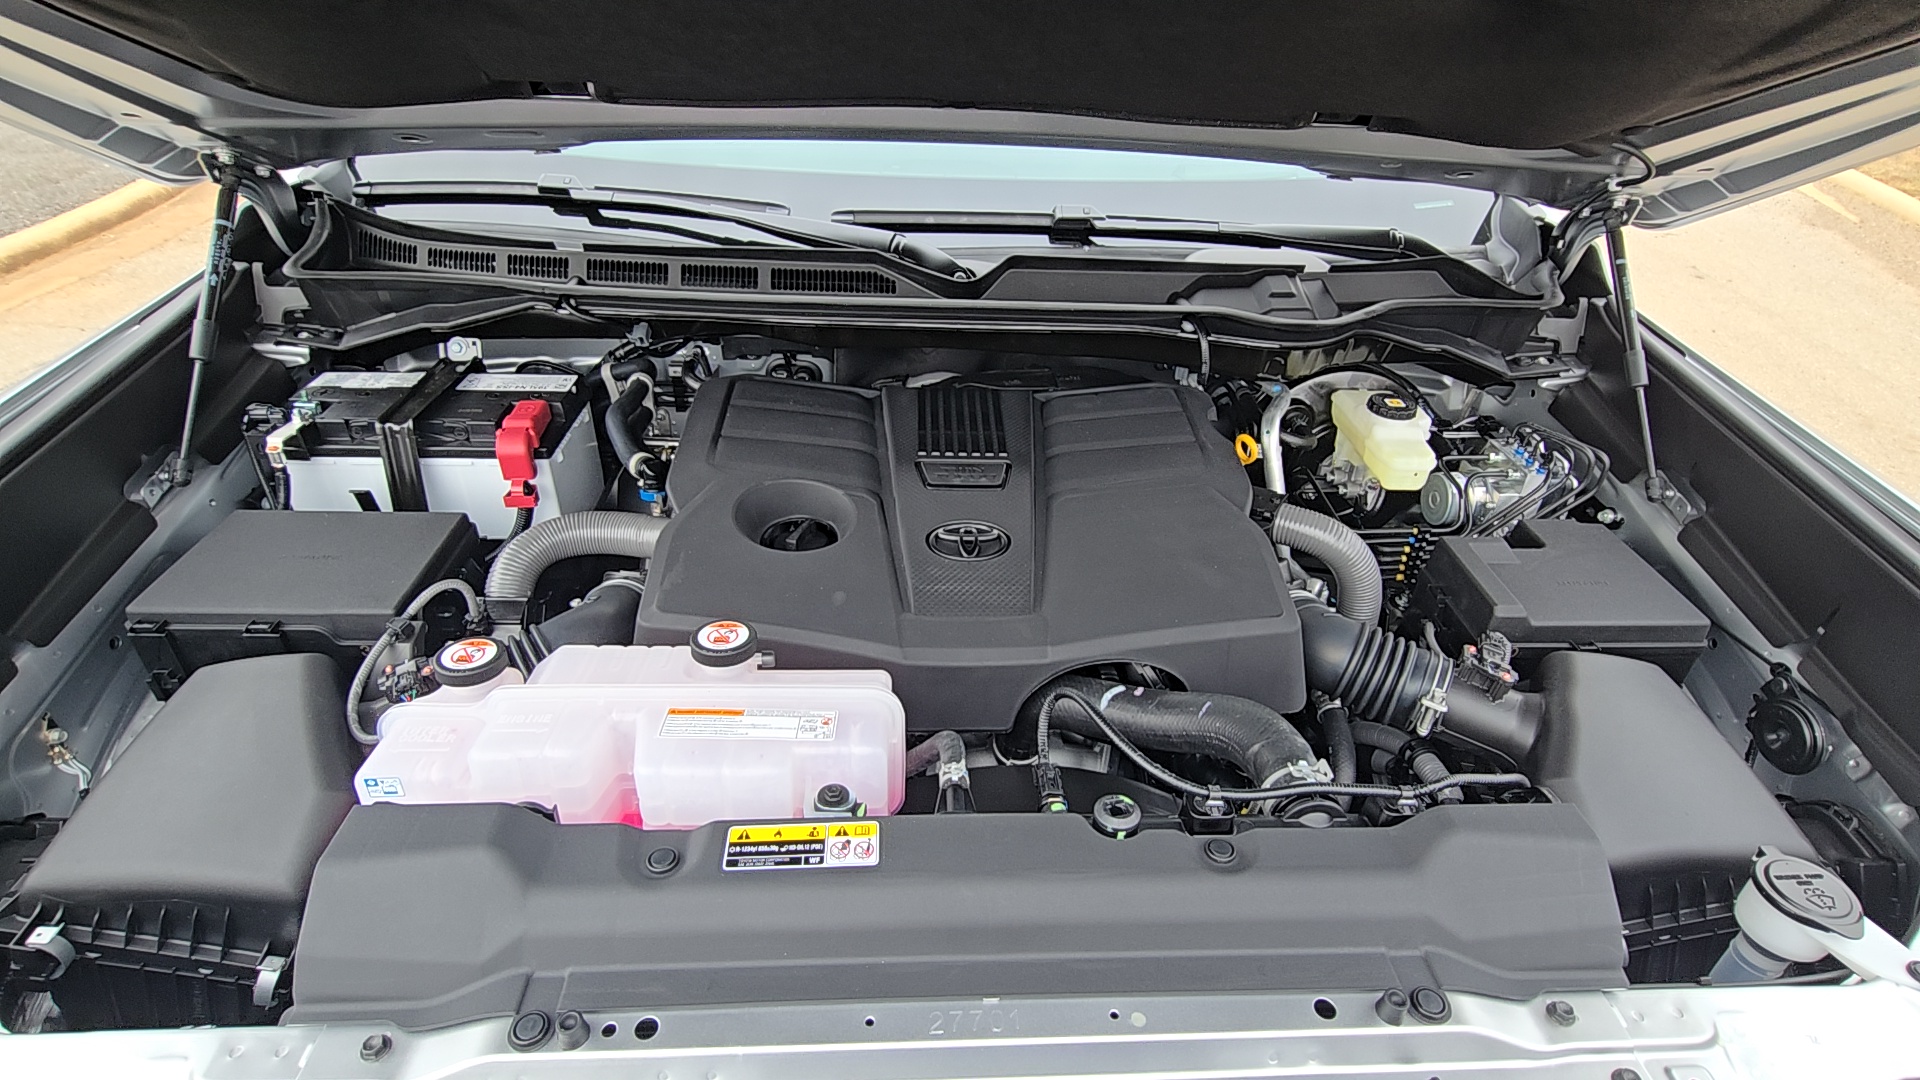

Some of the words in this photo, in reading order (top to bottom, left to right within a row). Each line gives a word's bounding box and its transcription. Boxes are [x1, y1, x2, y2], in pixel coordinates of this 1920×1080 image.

[496, 713, 553, 724] ENGINE
[399, 734, 456, 743] COOLER
[809, 856, 820, 864] WF
